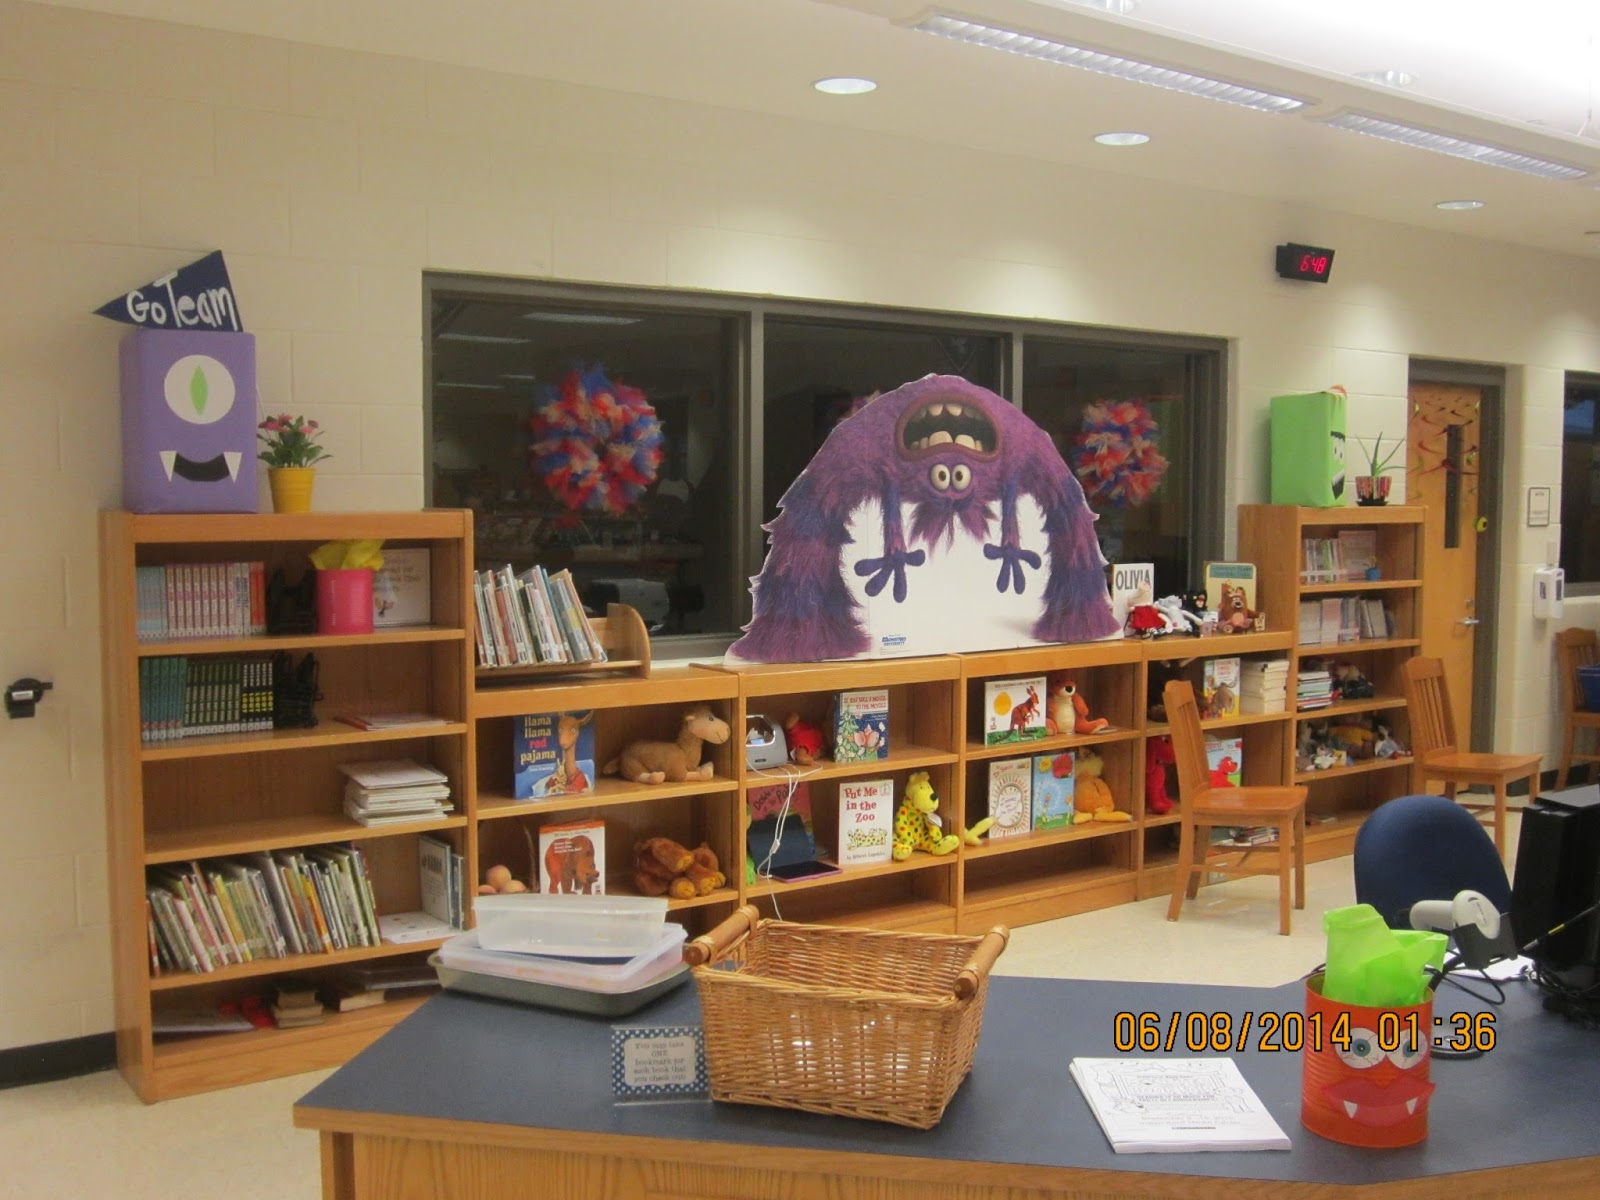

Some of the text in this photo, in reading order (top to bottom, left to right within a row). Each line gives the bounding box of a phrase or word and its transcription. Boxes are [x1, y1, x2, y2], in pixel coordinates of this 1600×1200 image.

[126, 271, 238, 331] Go Team
[1115, 569, 1151, 590] OLIVIA
[525, 716, 552, 727] llama
[524, 727, 552, 738] llama
[529, 737, 547, 749] red
[520, 749, 556, 765] pajama
[844, 786, 878, 799] Put Me
[846, 800, 877, 811] in the
[855, 812, 875, 823] Zoo
